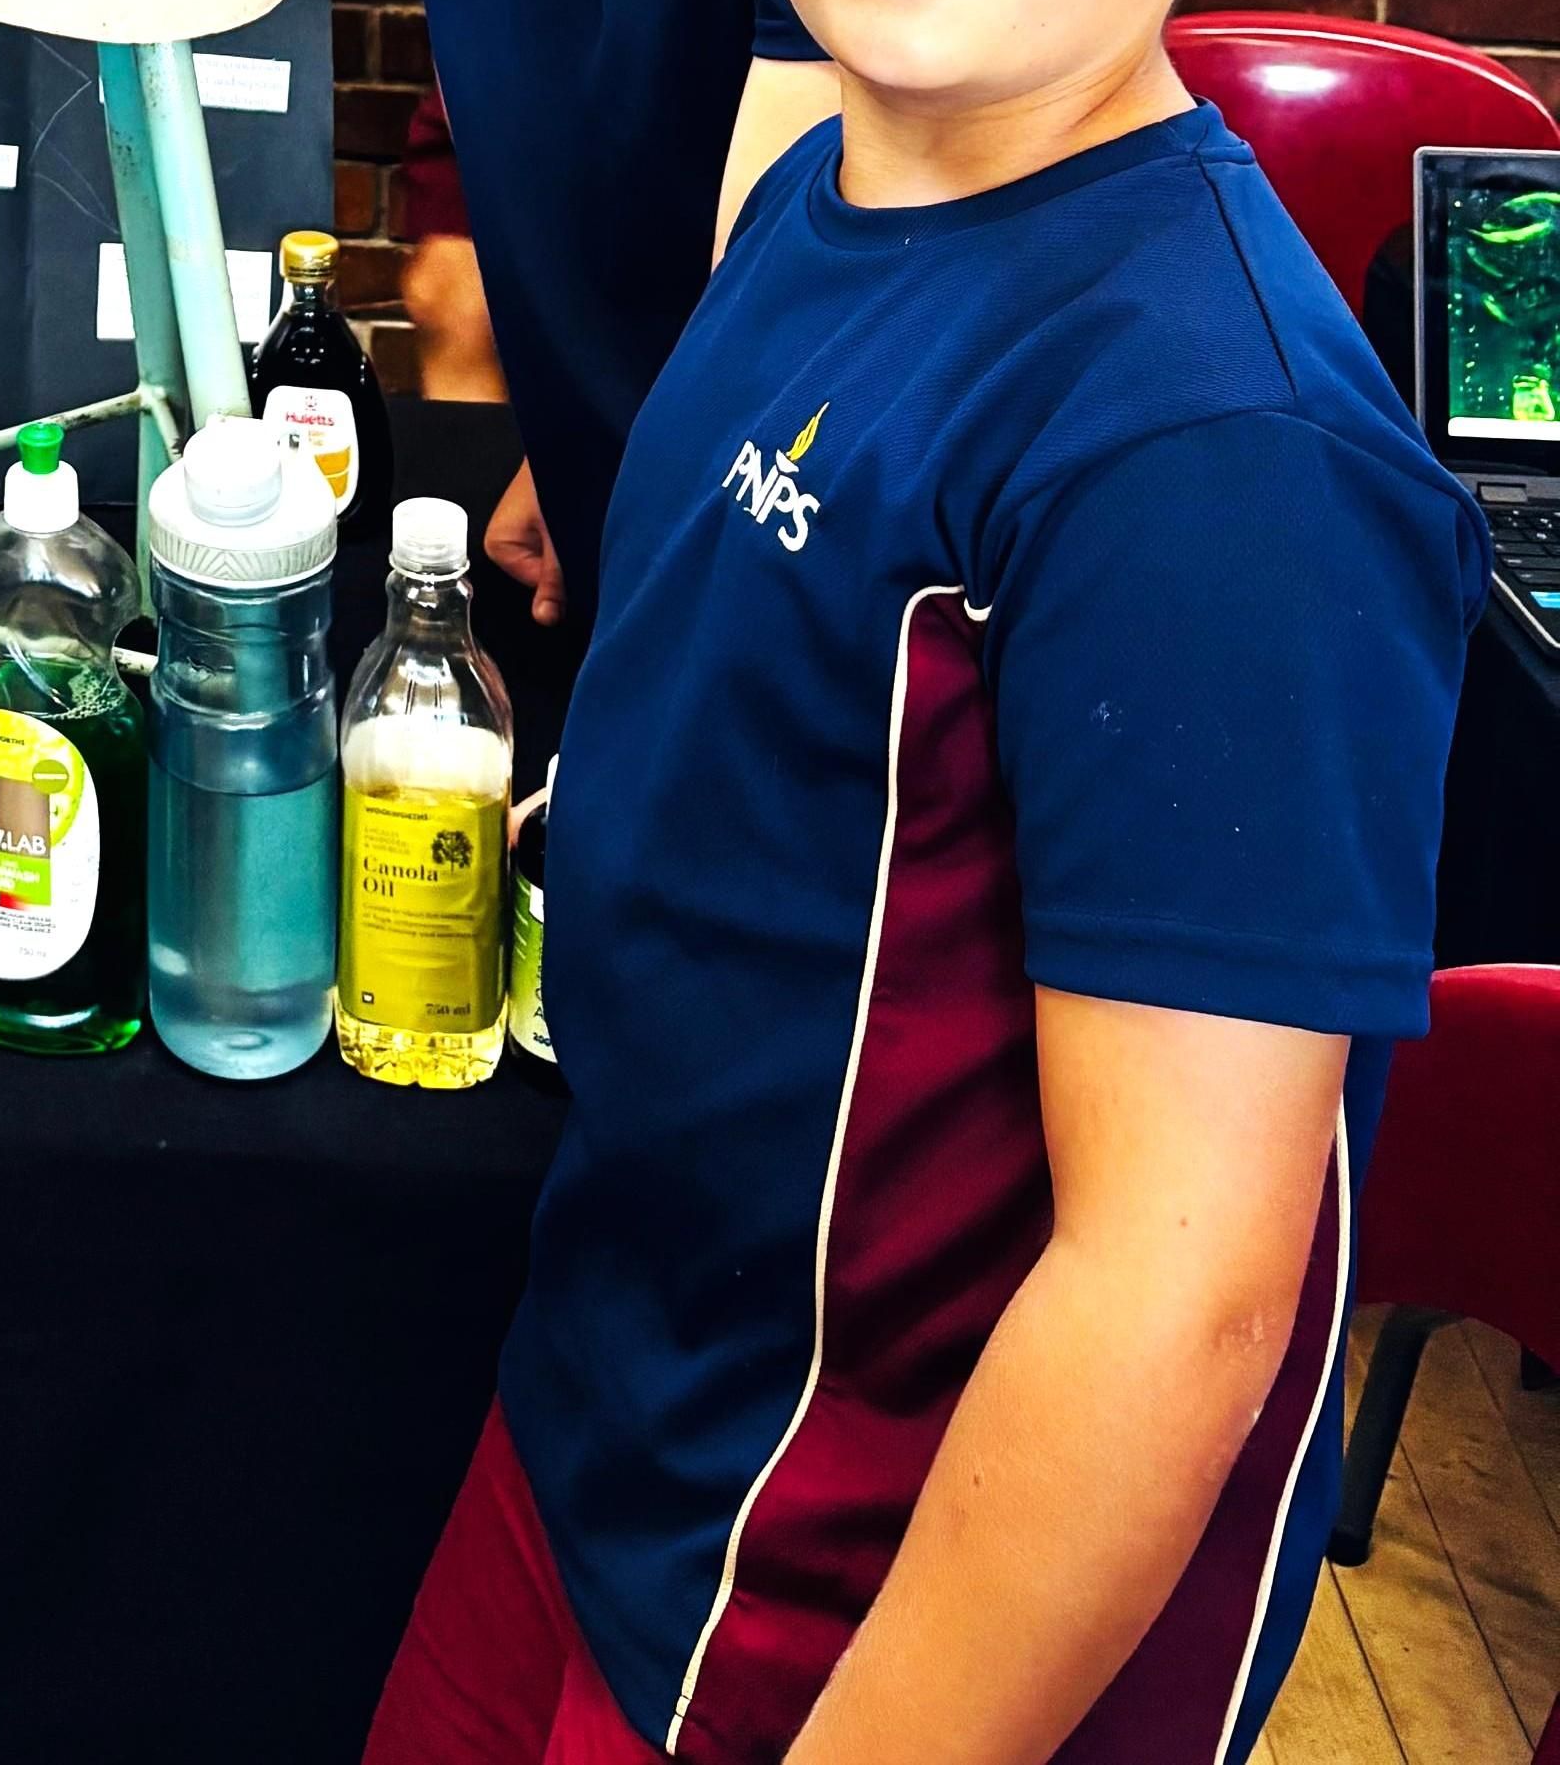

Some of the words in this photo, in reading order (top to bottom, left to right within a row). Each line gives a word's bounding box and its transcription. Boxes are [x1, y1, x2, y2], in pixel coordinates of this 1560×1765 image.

[721, 439, 821, 552] PNPS
[363, 855, 439, 882] Canola
[363, 876, 394, 898] Oil
